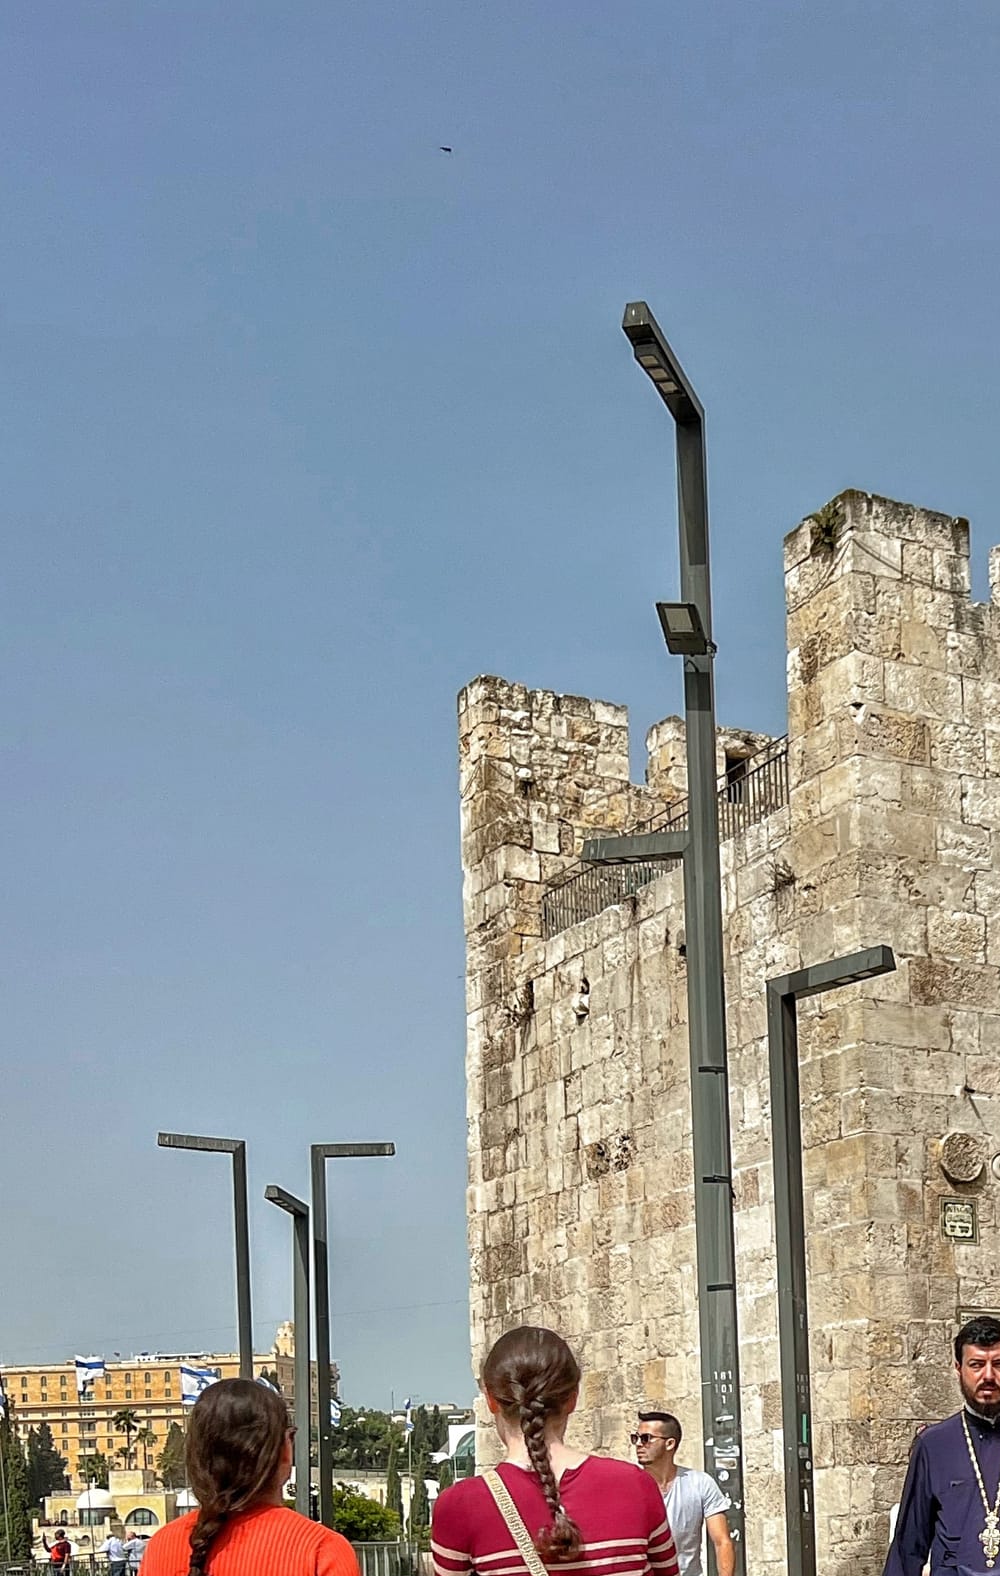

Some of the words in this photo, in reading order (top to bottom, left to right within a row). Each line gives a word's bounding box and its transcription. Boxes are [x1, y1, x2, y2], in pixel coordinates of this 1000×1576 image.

[714, 1370, 732, 1380] 181
[714, 1383, 733, 1393] 101
[721, 1394, 727, 1405] 1
